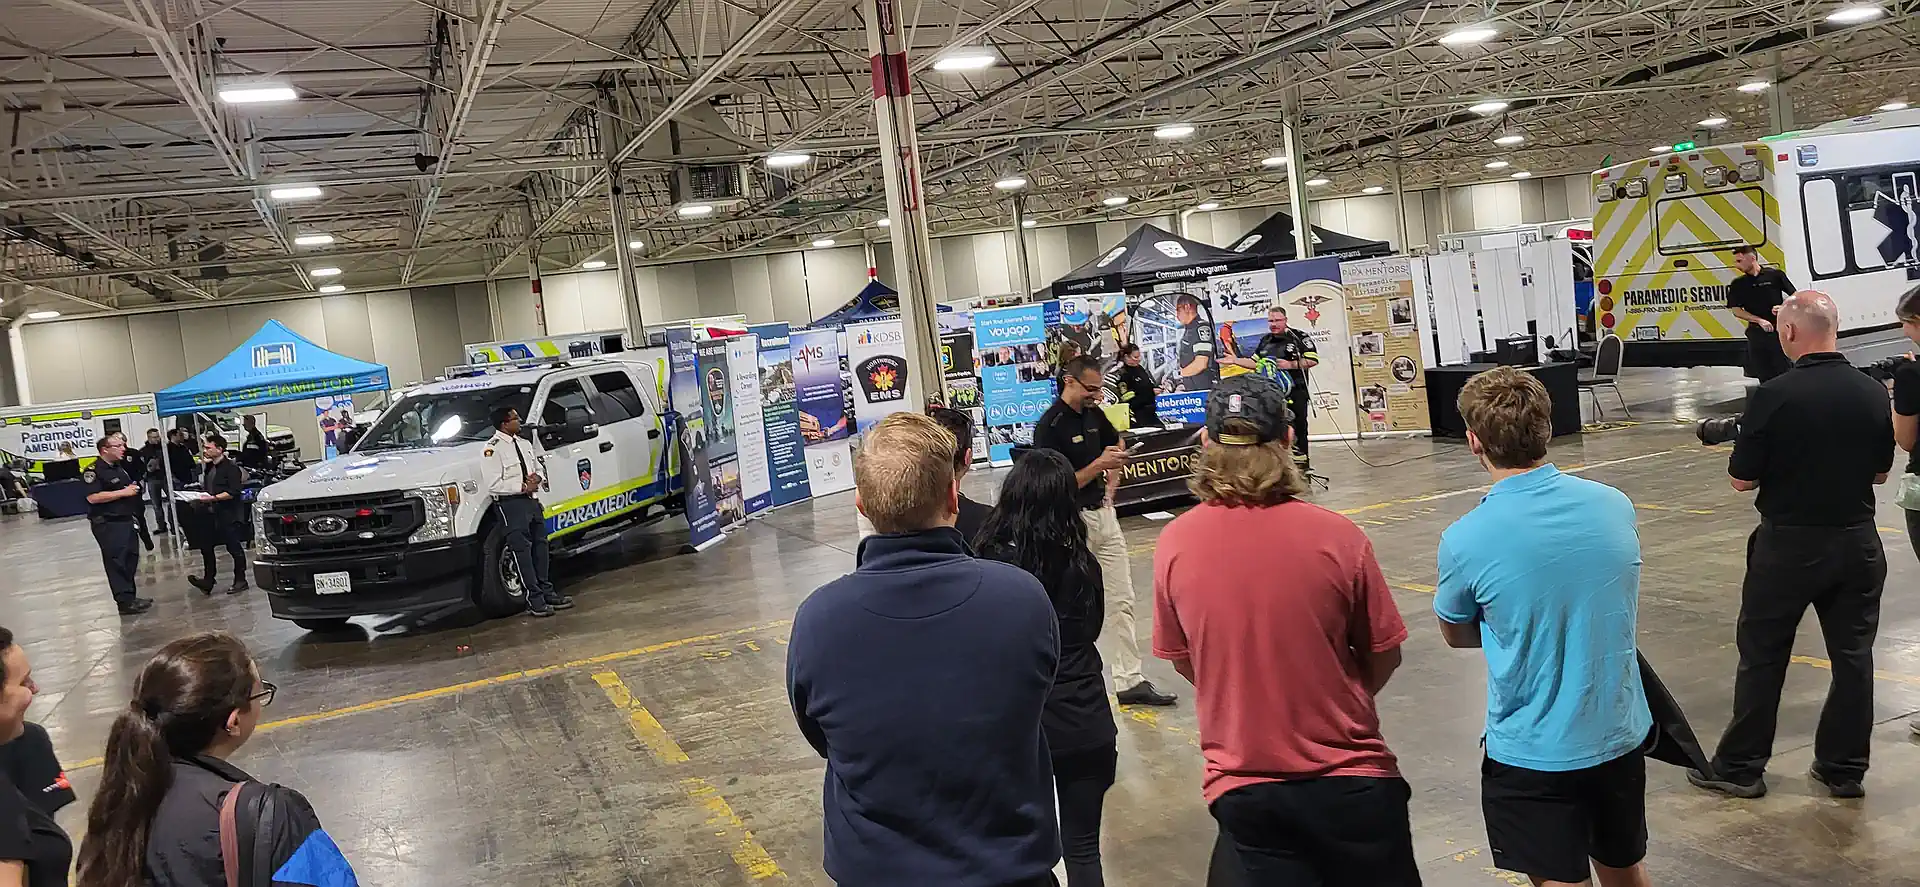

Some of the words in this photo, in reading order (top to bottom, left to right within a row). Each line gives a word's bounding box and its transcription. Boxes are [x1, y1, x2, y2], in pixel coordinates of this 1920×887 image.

[1156, 267, 1196, 280] Community
[1196, 264, 1228, 277] Programs
[1365, 264, 1406, 276] MENTORS
[1357, 278, 1394, 288] Paramedic
[1623, 287, 1688, 306] PARAMEDIC
[1690, 285, 1732, 303] SERVIC
[859, 314, 901, 323] PARAMEDI
[873, 331, 903, 344] KDSB
[988, 325, 1031, 337] voyago
[797, 345, 823, 366] AMS
[866, 358, 899, 371] NORTHWEST
[193, 391, 232, 406] CITY
[239, 387, 262, 401] OF
[268, 375, 355, 397] HAMILTON
[870, 389, 901, 400] EMS
[1180, 406, 1206, 415] Service
[21, 427, 93, 443] Paramedic
[24, 440, 95, 453] AMBULNCE
[557, 489, 638, 529] PARAMEDIC
